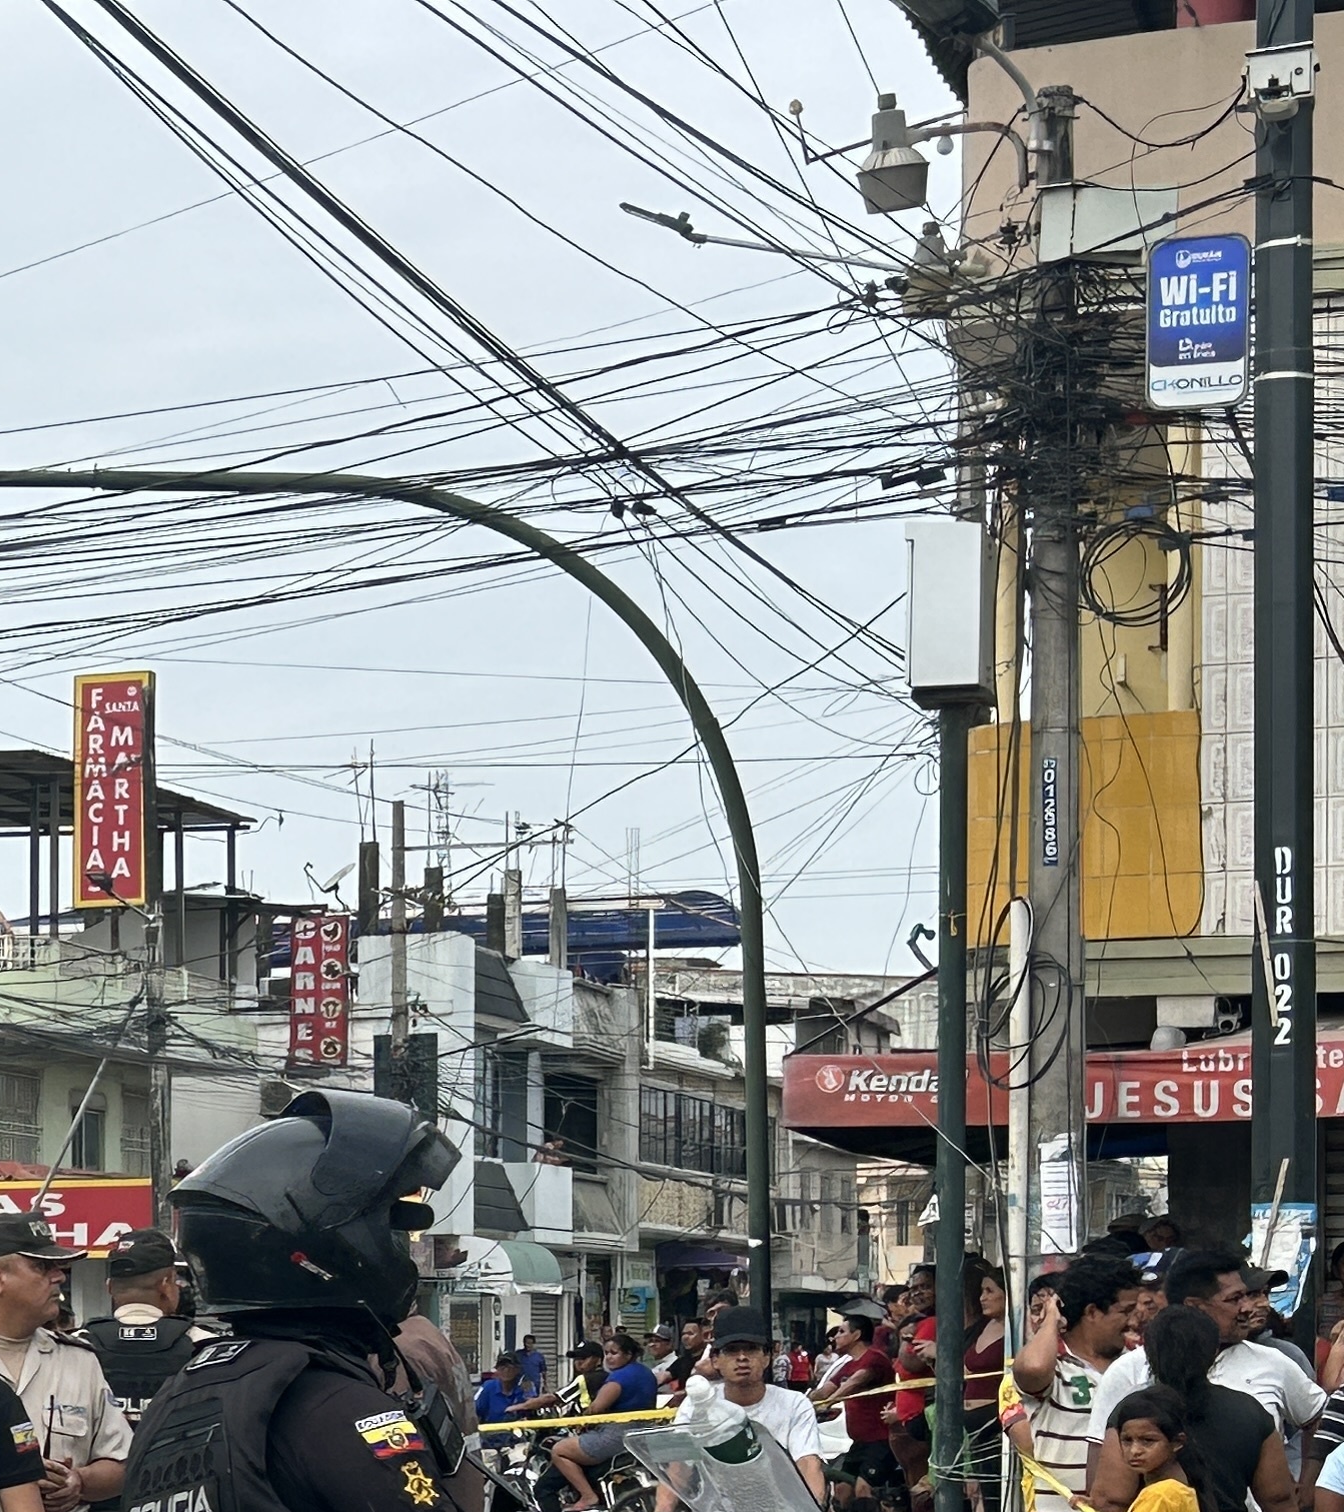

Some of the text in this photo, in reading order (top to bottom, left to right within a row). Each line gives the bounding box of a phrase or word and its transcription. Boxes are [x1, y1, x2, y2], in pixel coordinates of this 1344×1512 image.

[1160, 271, 1237, 307] Wi-Fi
[1159, 303, 1237, 328] Gratuito
[85, 688, 107, 892] FARMACIA
[110, 726, 133, 878] MARTHA
[1273, 847, 1292, 1045] DUR 022
[849, 1069, 969, 1092] Kenda
[1085, 1080, 1252, 1119] JESUS
